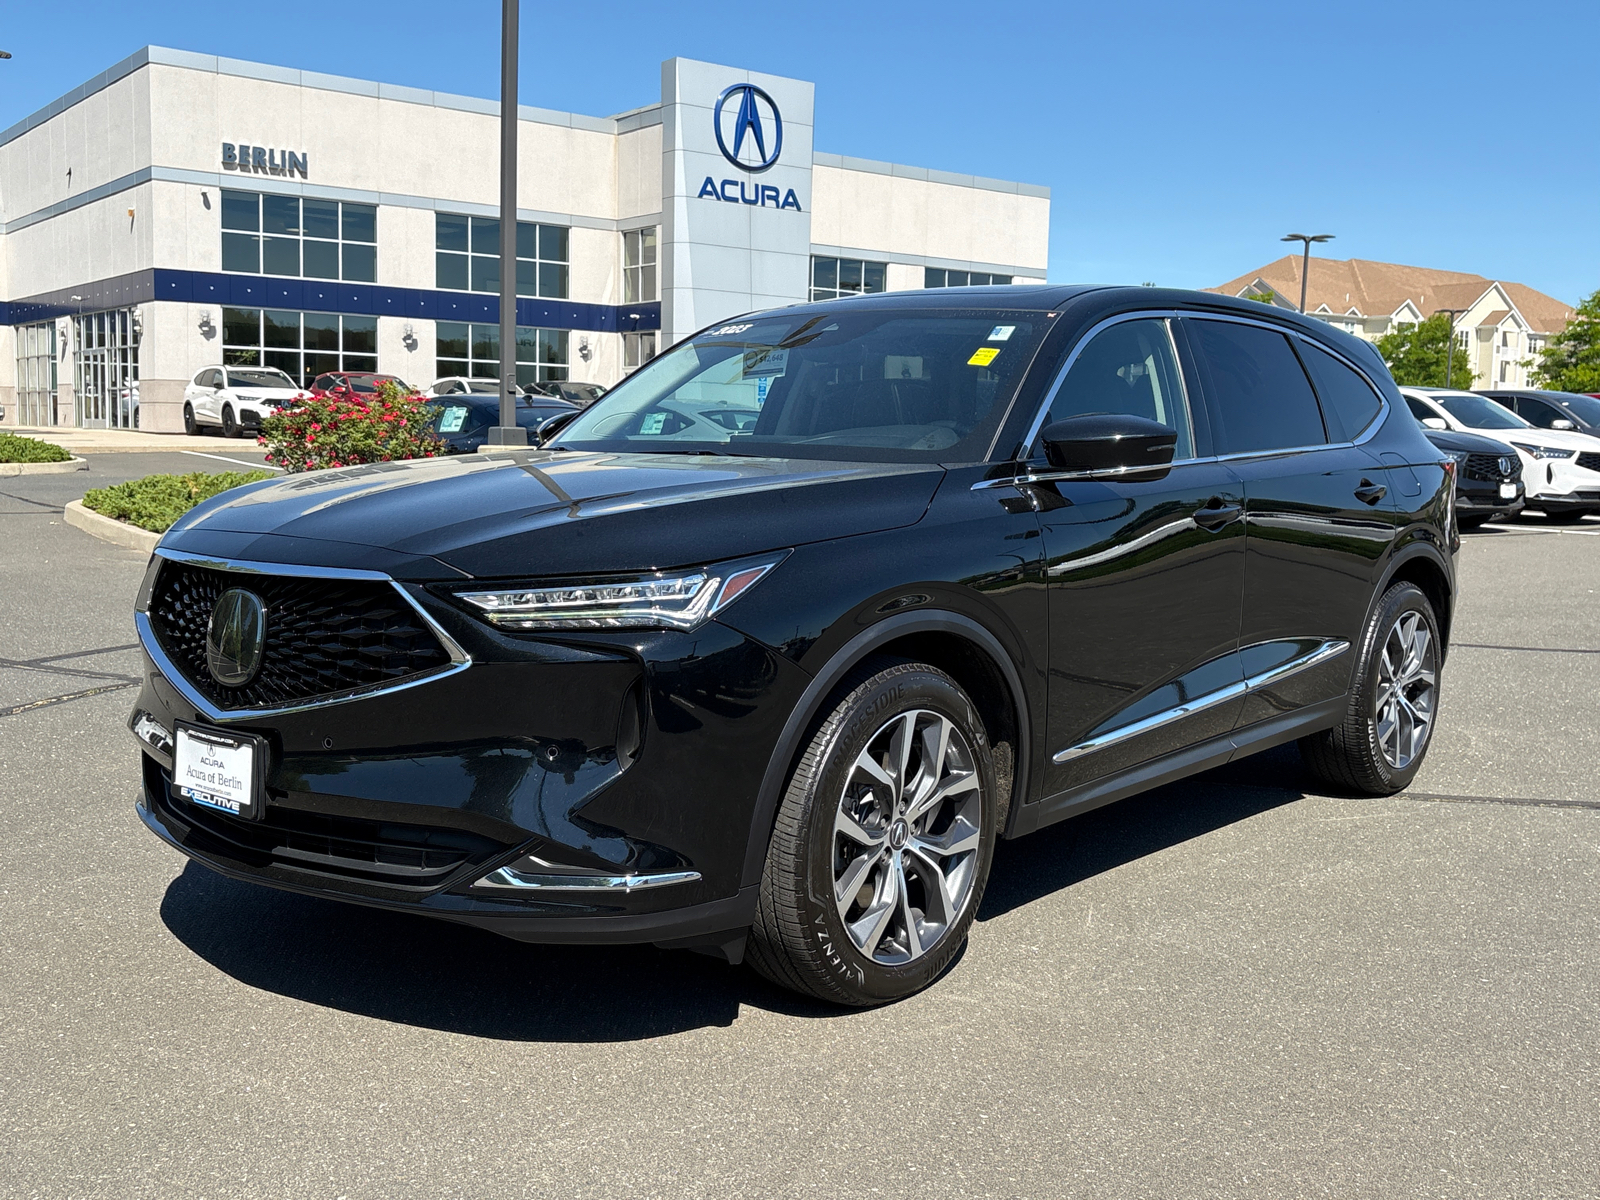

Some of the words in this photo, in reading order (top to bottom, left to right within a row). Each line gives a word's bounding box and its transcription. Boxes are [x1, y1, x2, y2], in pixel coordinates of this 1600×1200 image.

[222, 142, 308, 175] BERLIN
[698, 176, 801, 212] ACURA
[200, 756, 225, 769] ACURA
[186, 765, 206, 781] Acura
[208, 774, 216, 784] of
[218, 775, 242, 790] Berlin
[180, 786, 240, 812] EXECUTIVE
[815, 913, 855, 980] ALENZA
